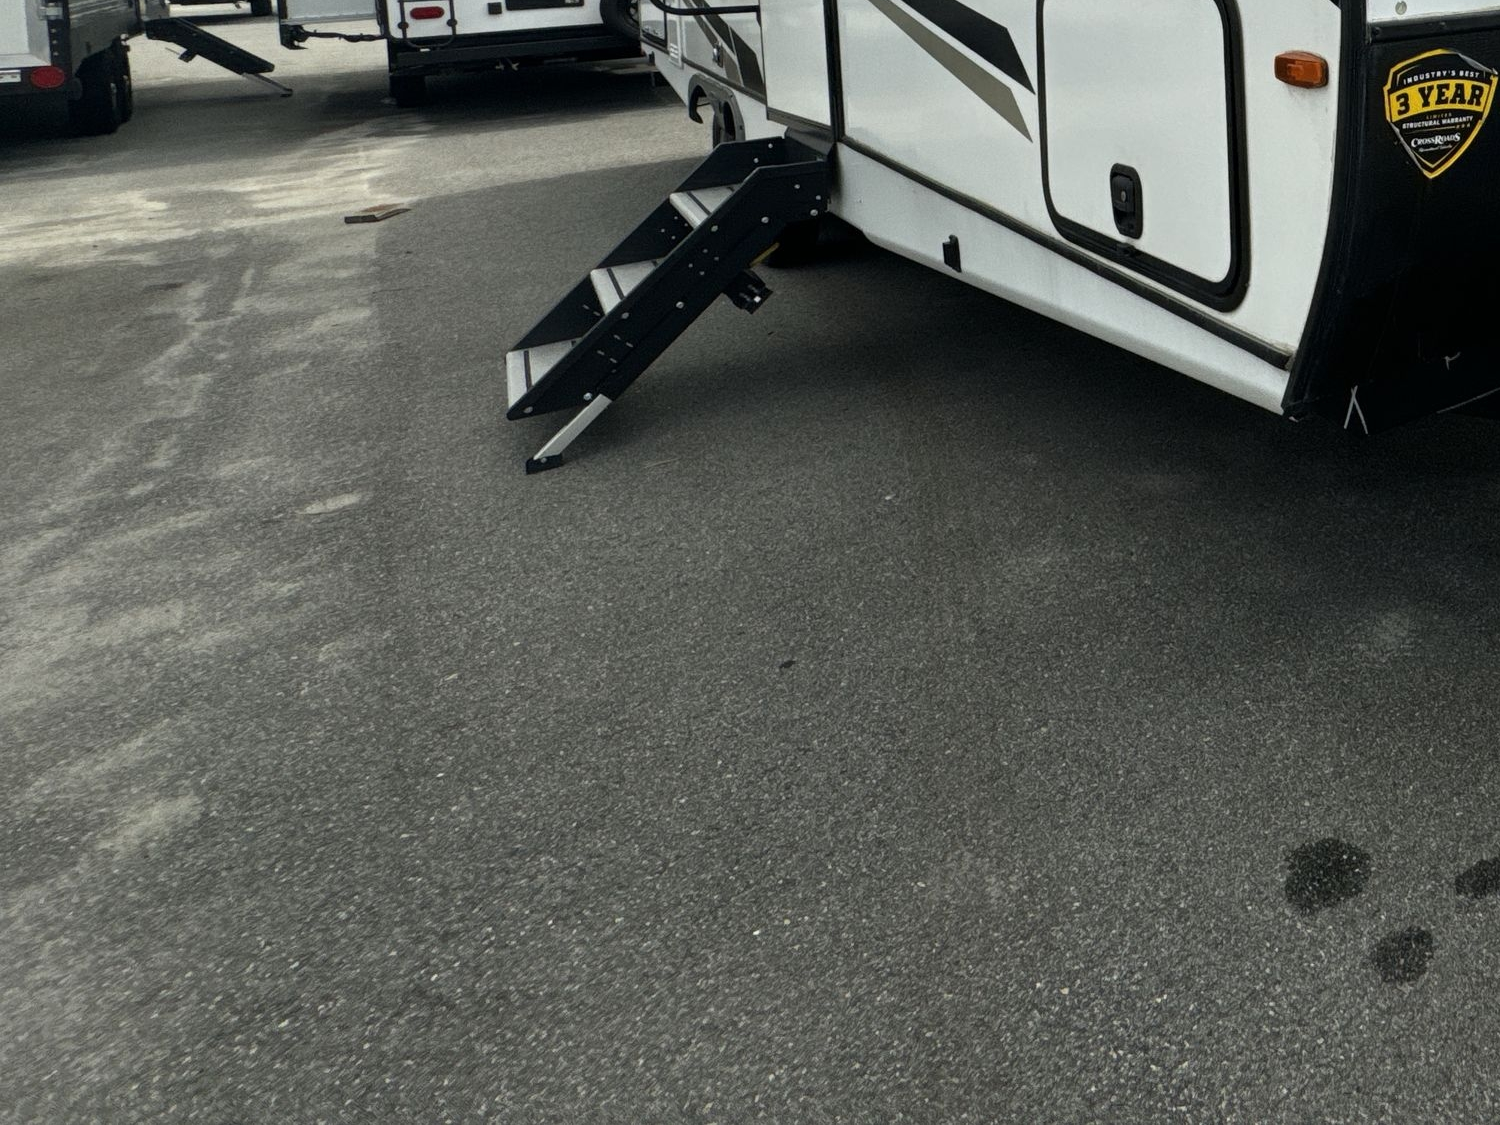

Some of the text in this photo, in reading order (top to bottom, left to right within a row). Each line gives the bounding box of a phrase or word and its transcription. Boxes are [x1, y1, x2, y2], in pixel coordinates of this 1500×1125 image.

[1403, 69, 1480, 85] INDUSTRY'S BEST
[1395, 82, 1485, 117] 3 YEAR
